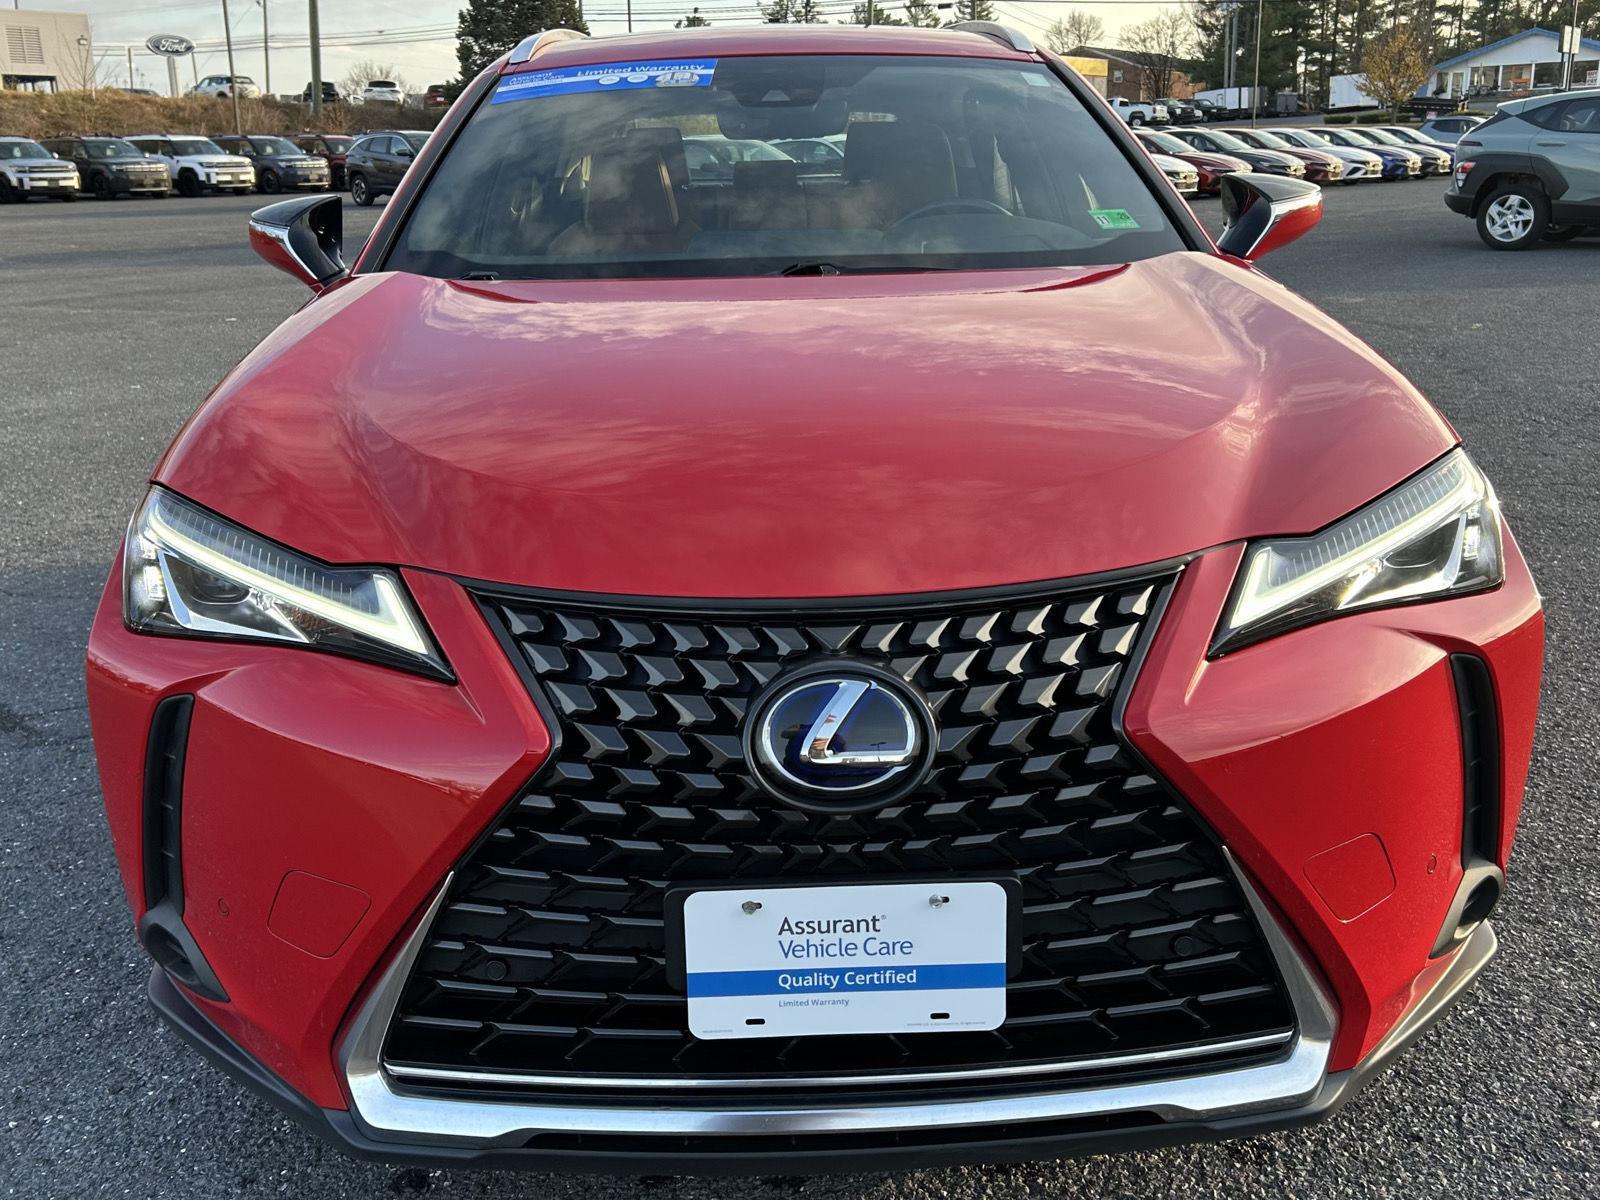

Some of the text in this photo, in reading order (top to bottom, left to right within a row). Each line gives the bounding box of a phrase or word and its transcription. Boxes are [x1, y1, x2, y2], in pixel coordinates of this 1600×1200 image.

[160, 39, 186, 51] Ford
[577, 64, 705, 76] Limited Warranty
[778, 915, 881, 936] Assurant
[778, 937, 914, 959] Vehicle Care
[778, 969, 917, 990] Quality Certified
[778, 1000, 810, 1008] Limited
